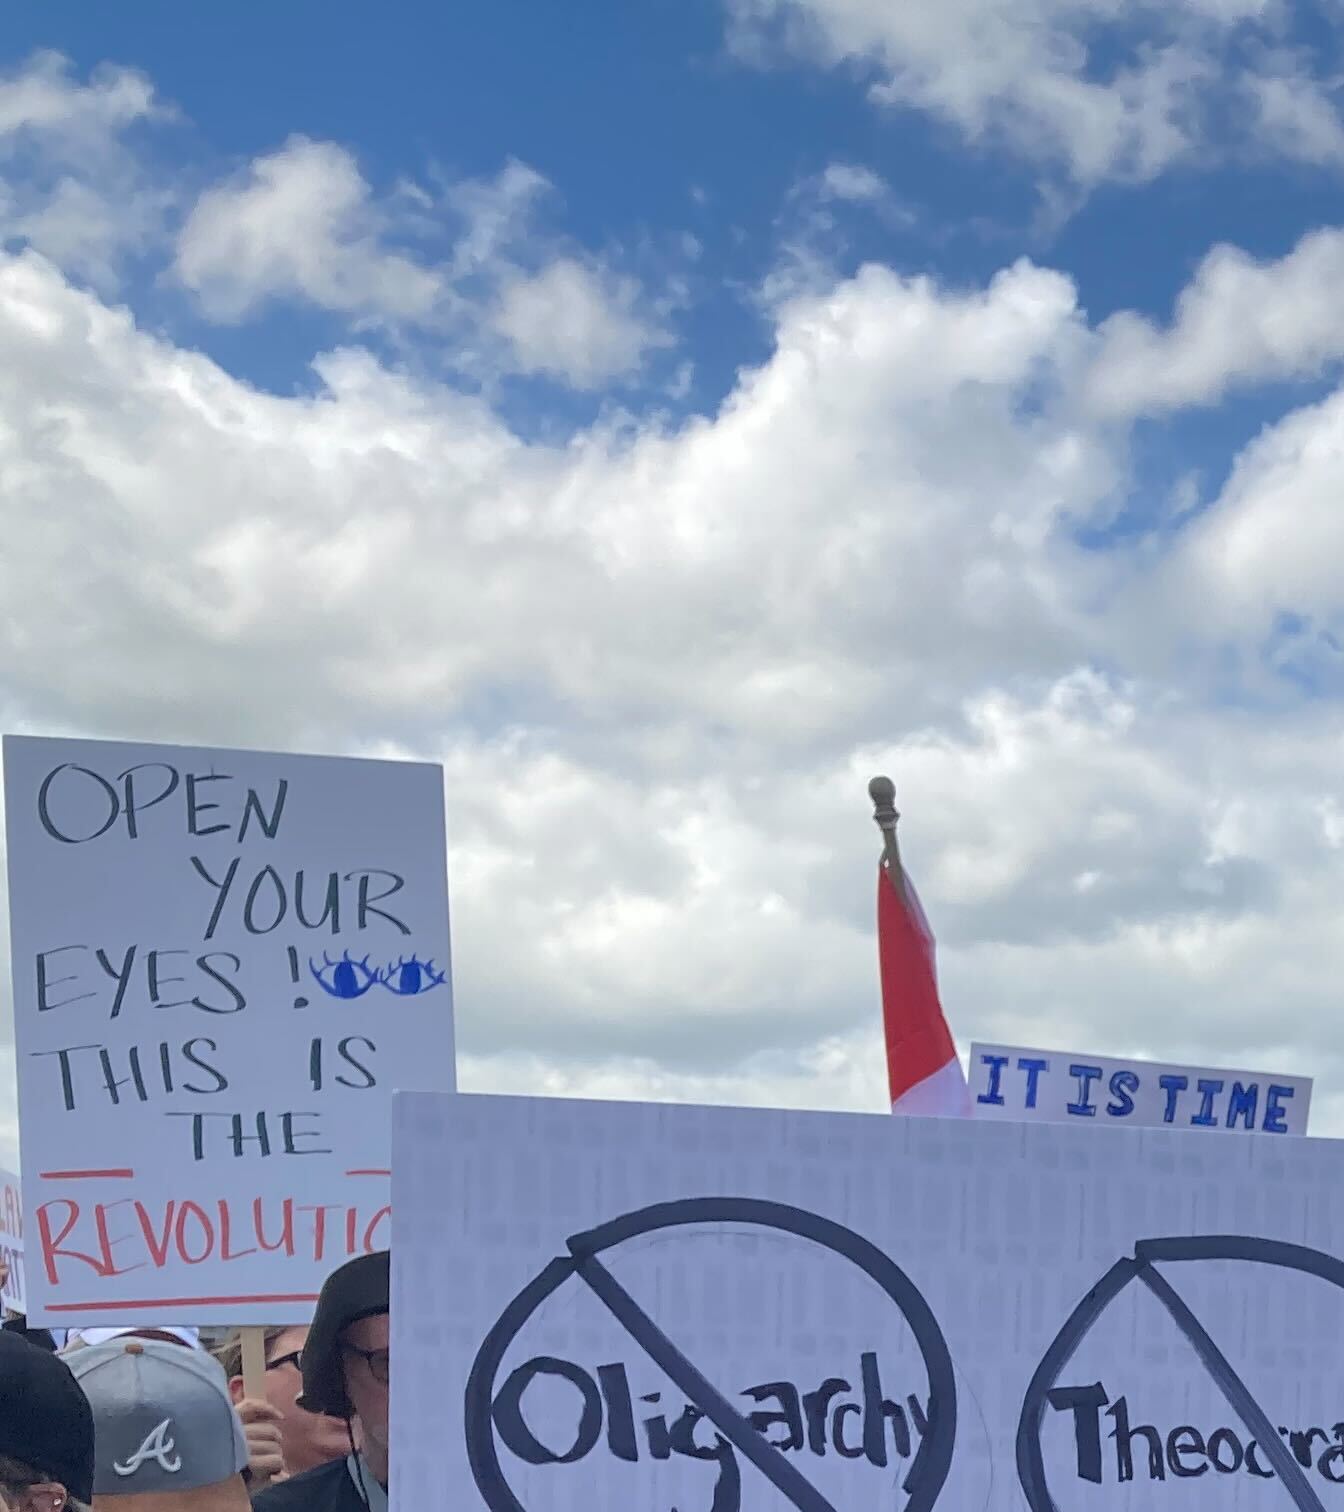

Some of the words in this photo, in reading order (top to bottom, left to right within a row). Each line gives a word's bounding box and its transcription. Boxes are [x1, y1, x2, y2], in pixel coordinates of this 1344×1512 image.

[38, 762, 288, 843] OPEN
[190, 856, 410, 941] YOUR
[29, 1037, 229, 1111] THIS
[310, 1035, 377, 1091] IS
[977, 1055, 1049, 1109] IT
[1067, 1064, 1140, 1117] IS
[1159, 1074, 1295, 1134] TIME
[164, 1110, 333, 1161] THE
